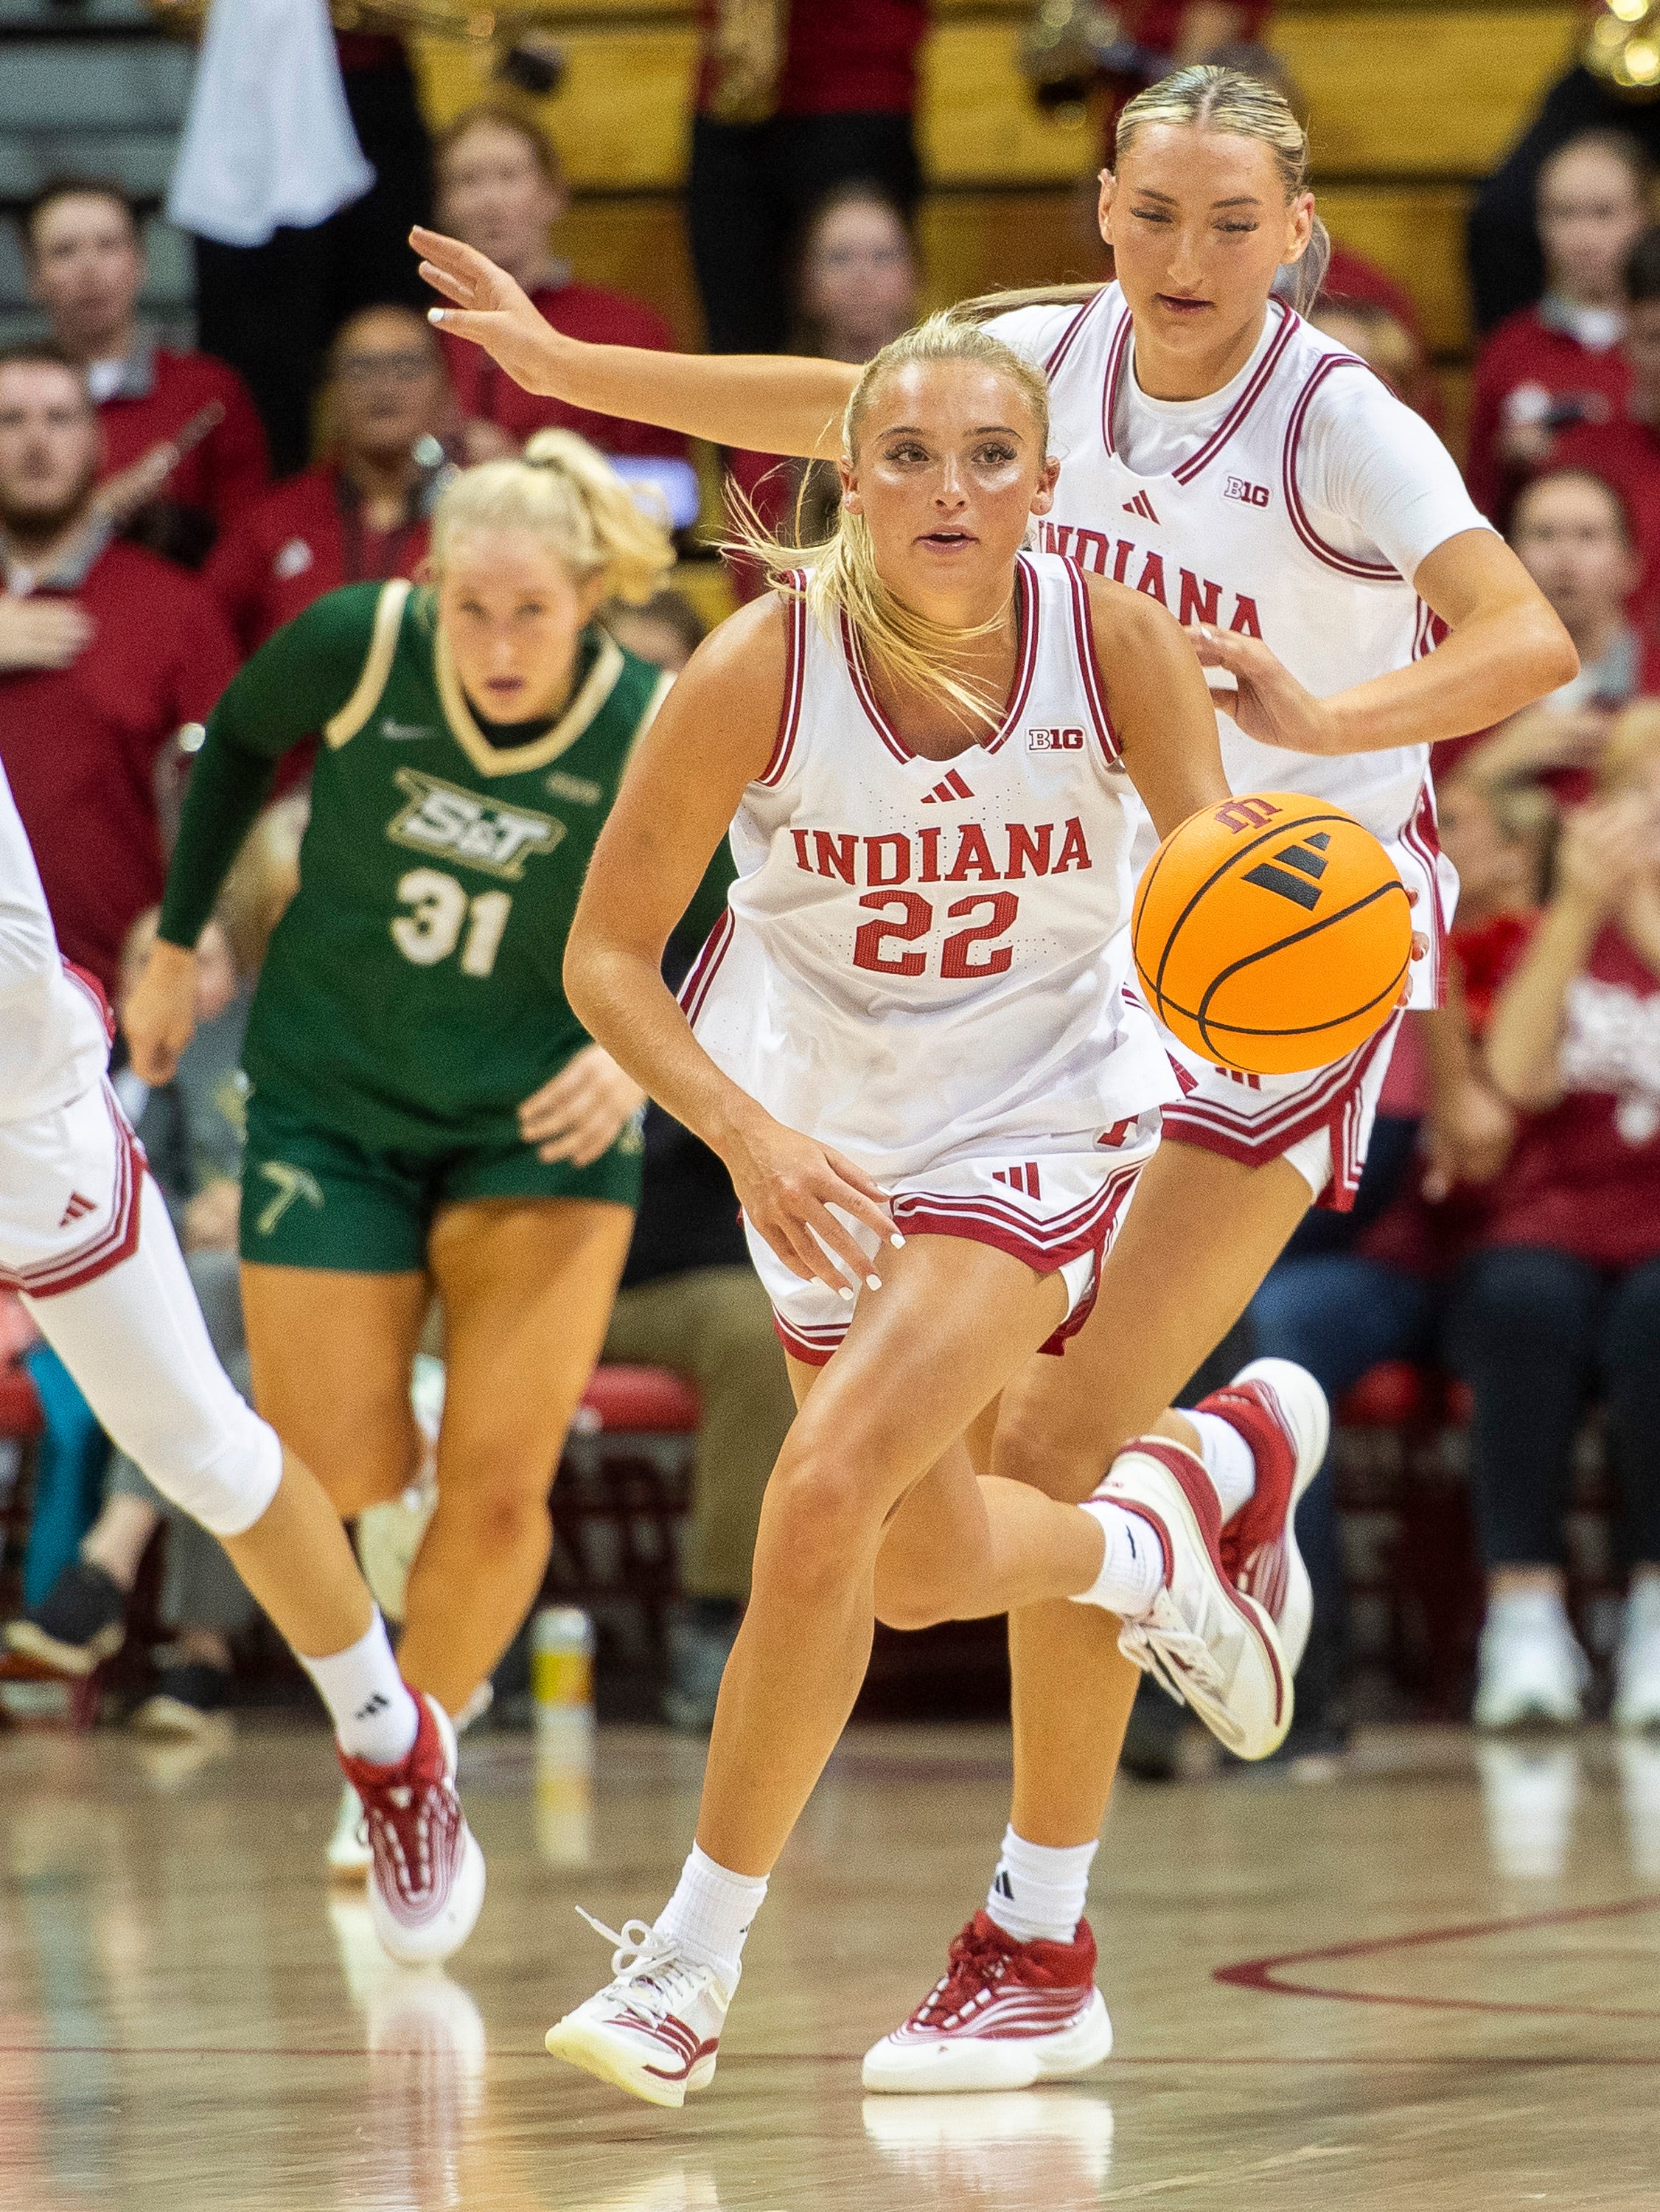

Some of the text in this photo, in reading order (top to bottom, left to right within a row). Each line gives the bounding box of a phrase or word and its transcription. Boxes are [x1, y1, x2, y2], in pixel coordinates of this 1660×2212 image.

[790, 816, 1092, 886] INDIANA
[389, 866, 513, 978] 31
[853, 889, 1019, 978] 22
